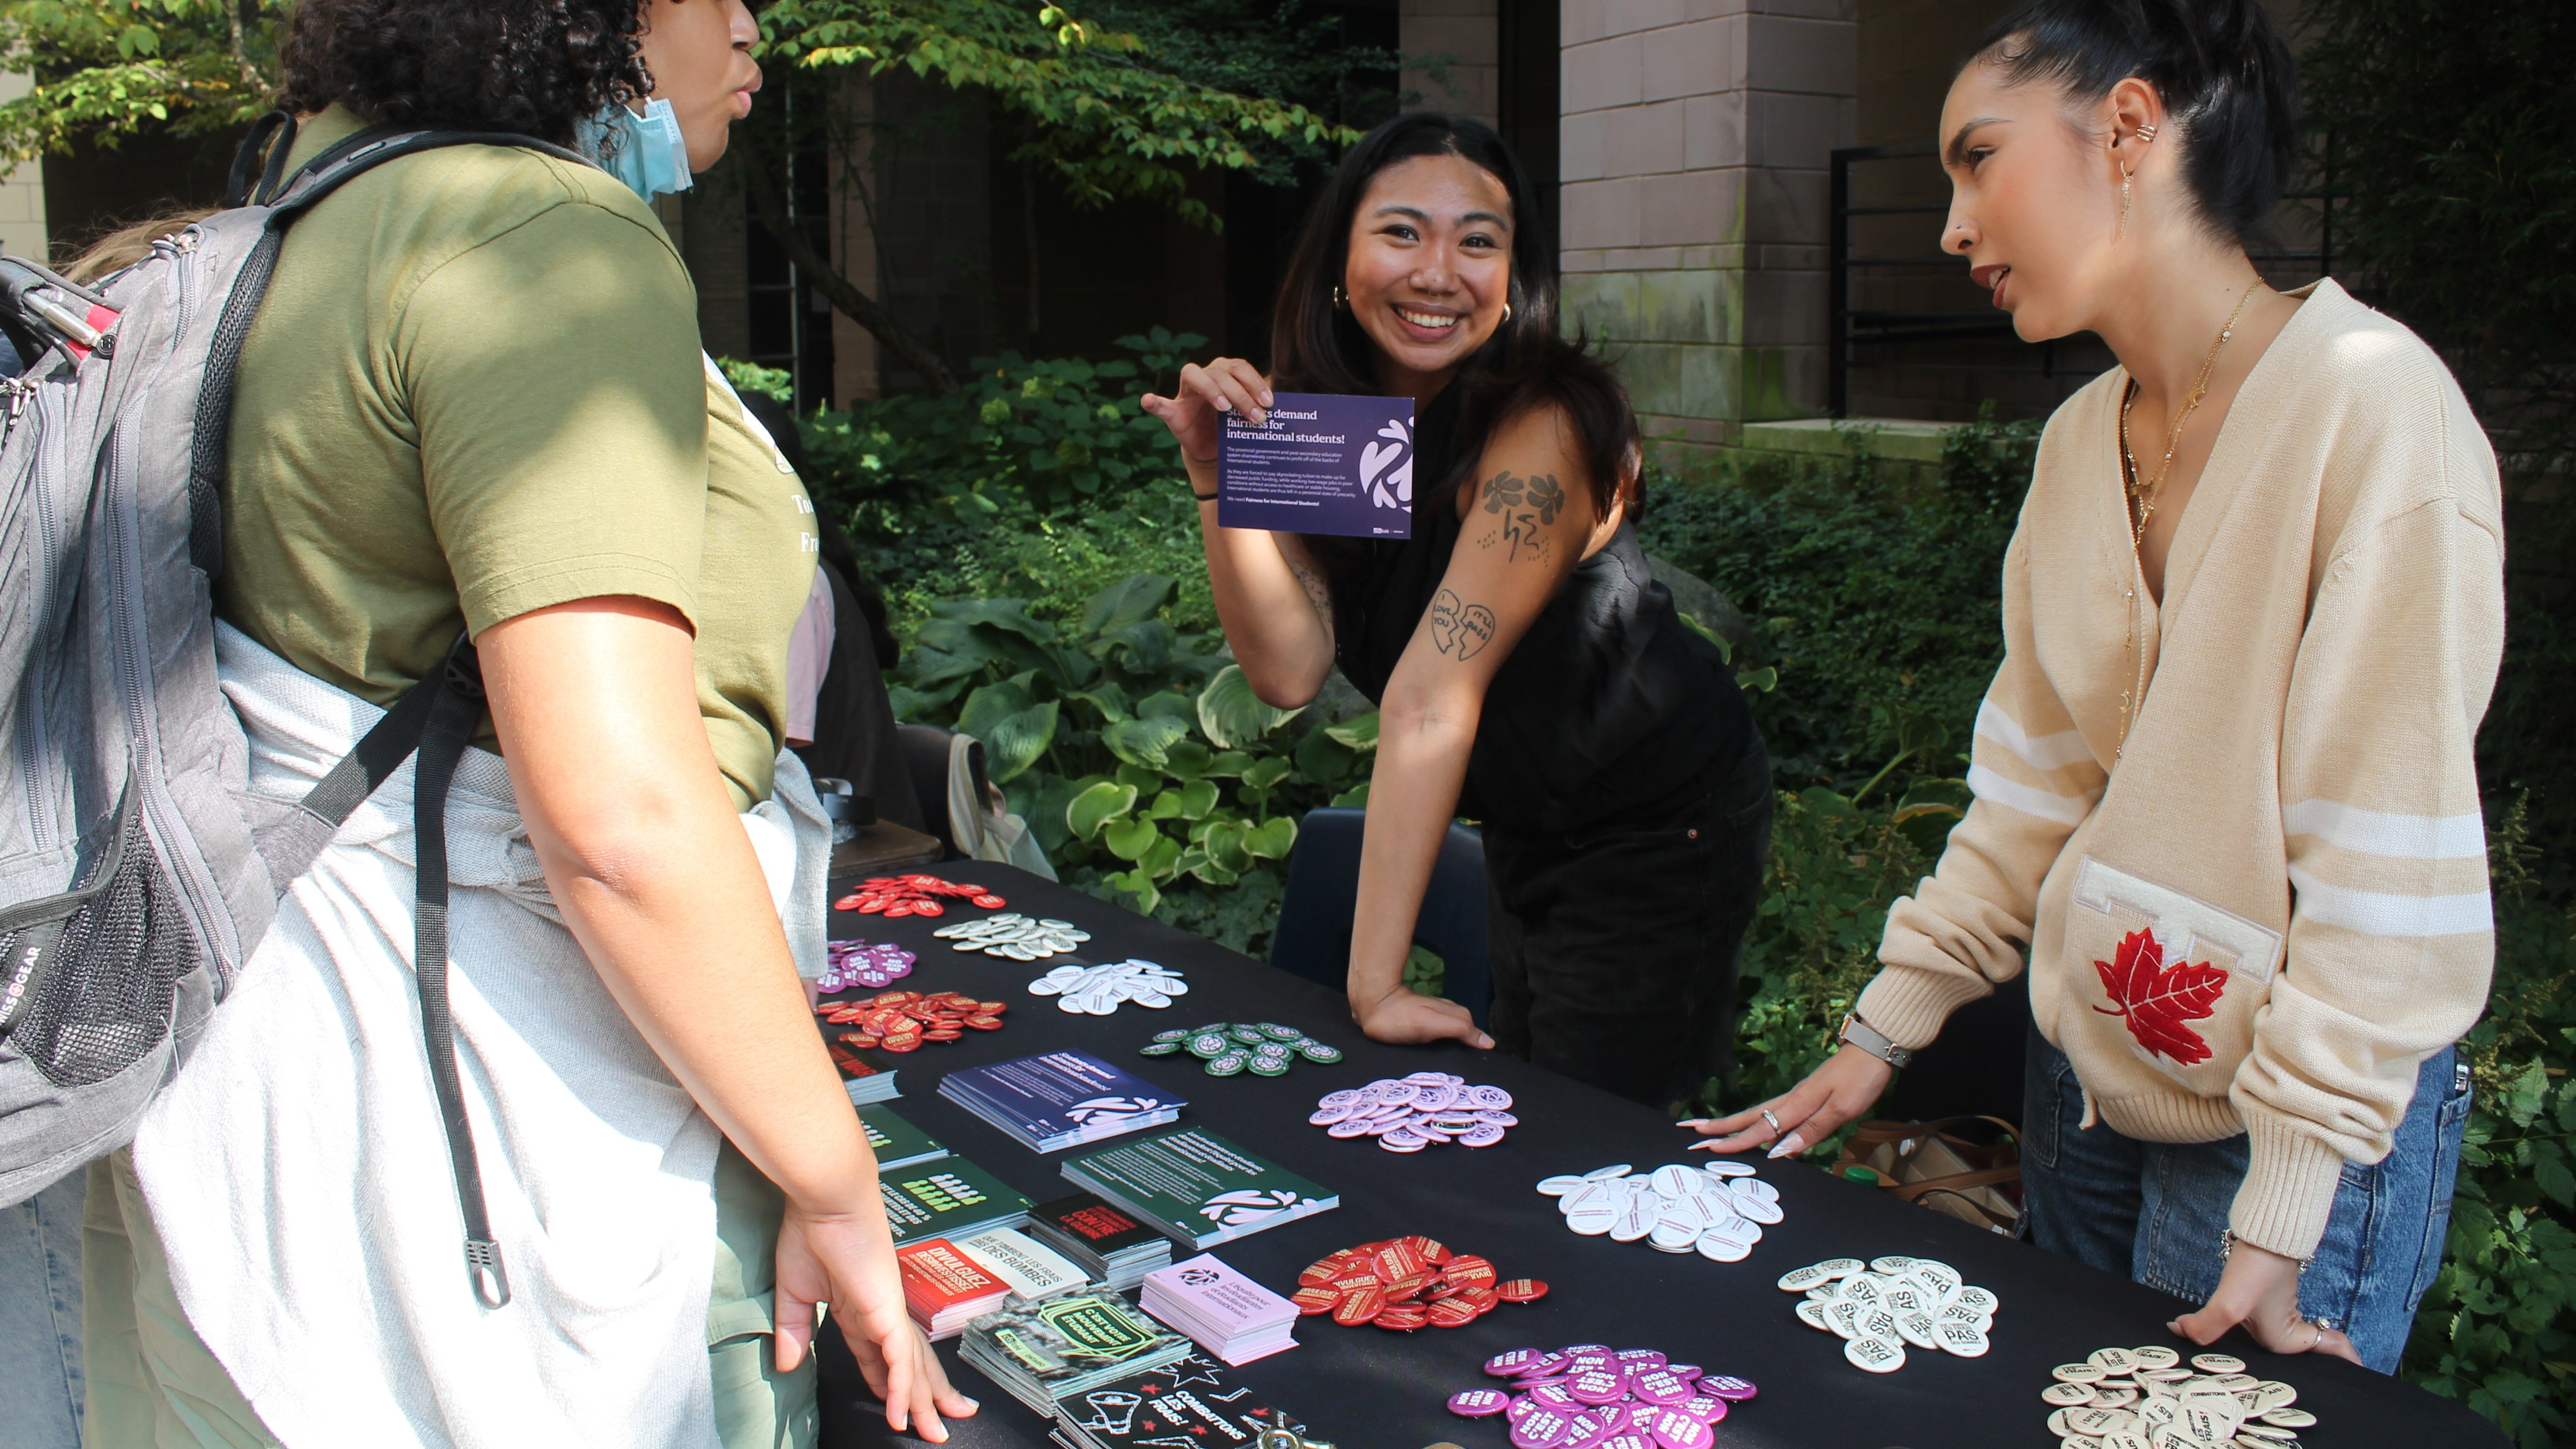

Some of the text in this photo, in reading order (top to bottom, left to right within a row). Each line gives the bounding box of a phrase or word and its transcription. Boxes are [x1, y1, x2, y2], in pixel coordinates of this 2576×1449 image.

[1274, 409, 1317, 420] demand
[1269, 420, 1285, 430] for
[1227, 429, 1345, 444] international students!
[1434, 605, 1451, 615] LOVE
[1434, 617, 1449, 627] YOU
[839, 1059, 879, 1078] WAR
[1072, 1210, 1120, 1236] CONTRE
[974, 1239, 1052, 1287] PAS DES BOMBES
[982, 1235, 1063, 1283] QUE TOMBENT LES FRAIS
[1921, 1272, 1951, 1294] PAS
[1201, 1290, 1250, 1319] internationaux
[1252, 1295, 1271, 1307] pour
[1869, 1312, 1893, 1335] PAS
[1945, 1307, 1980, 1324] PAS
[1061, 1313, 1100, 1344] ÉTUDIANT
[1073, 1312, 1122, 1346] MOUVEMENT
[1085, 1309, 1132, 1343] C'EST VOTRE
[1945, 1330, 1980, 1341] PAS
[1505, 1351, 1516, 1366] C'EST
[1518, 1350, 1528, 1362] NON
[1861, 1339, 1893, 1361] PAS
[1493, 1355, 1504, 1368] NON
[1576, 1376, 1617, 1388] C'EST
[1585, 1371, 1617, 1380] NON
[1640, 1371, 1669, 1383] NON
[1643, 1376, 1679, 1391] C'EST
[1577, 1383, 1609, 1394] NON
[1655, 1384, 1684, 1397] NON
[1161, 1394, 1187, 1411] LES
[1456, 1392, 1471, 1406] NON
[1468, 1391, 1485, 1407] C'EST
[1482, 1392, 1497, 1406] NON
[1148, 1398, 1190, 1427] FRAIS!
[1175, 1390, 1248, 1441] COMBATTONS
[1519, 1411, 1542, 1435] NON
[1527, 1411, 1555, 1440] C'EST
[1540, 1417, 1565, 1442] NON
[1658, 1411, 1678, 1433] NON
[1669, 1414, 1691, 1443] C'EST
[2200, 1410, 2212, 1441] FRAIS!
[1683, 1421, 1702, 1445] NON
[2197, 1428, 2206, 1442] LES
